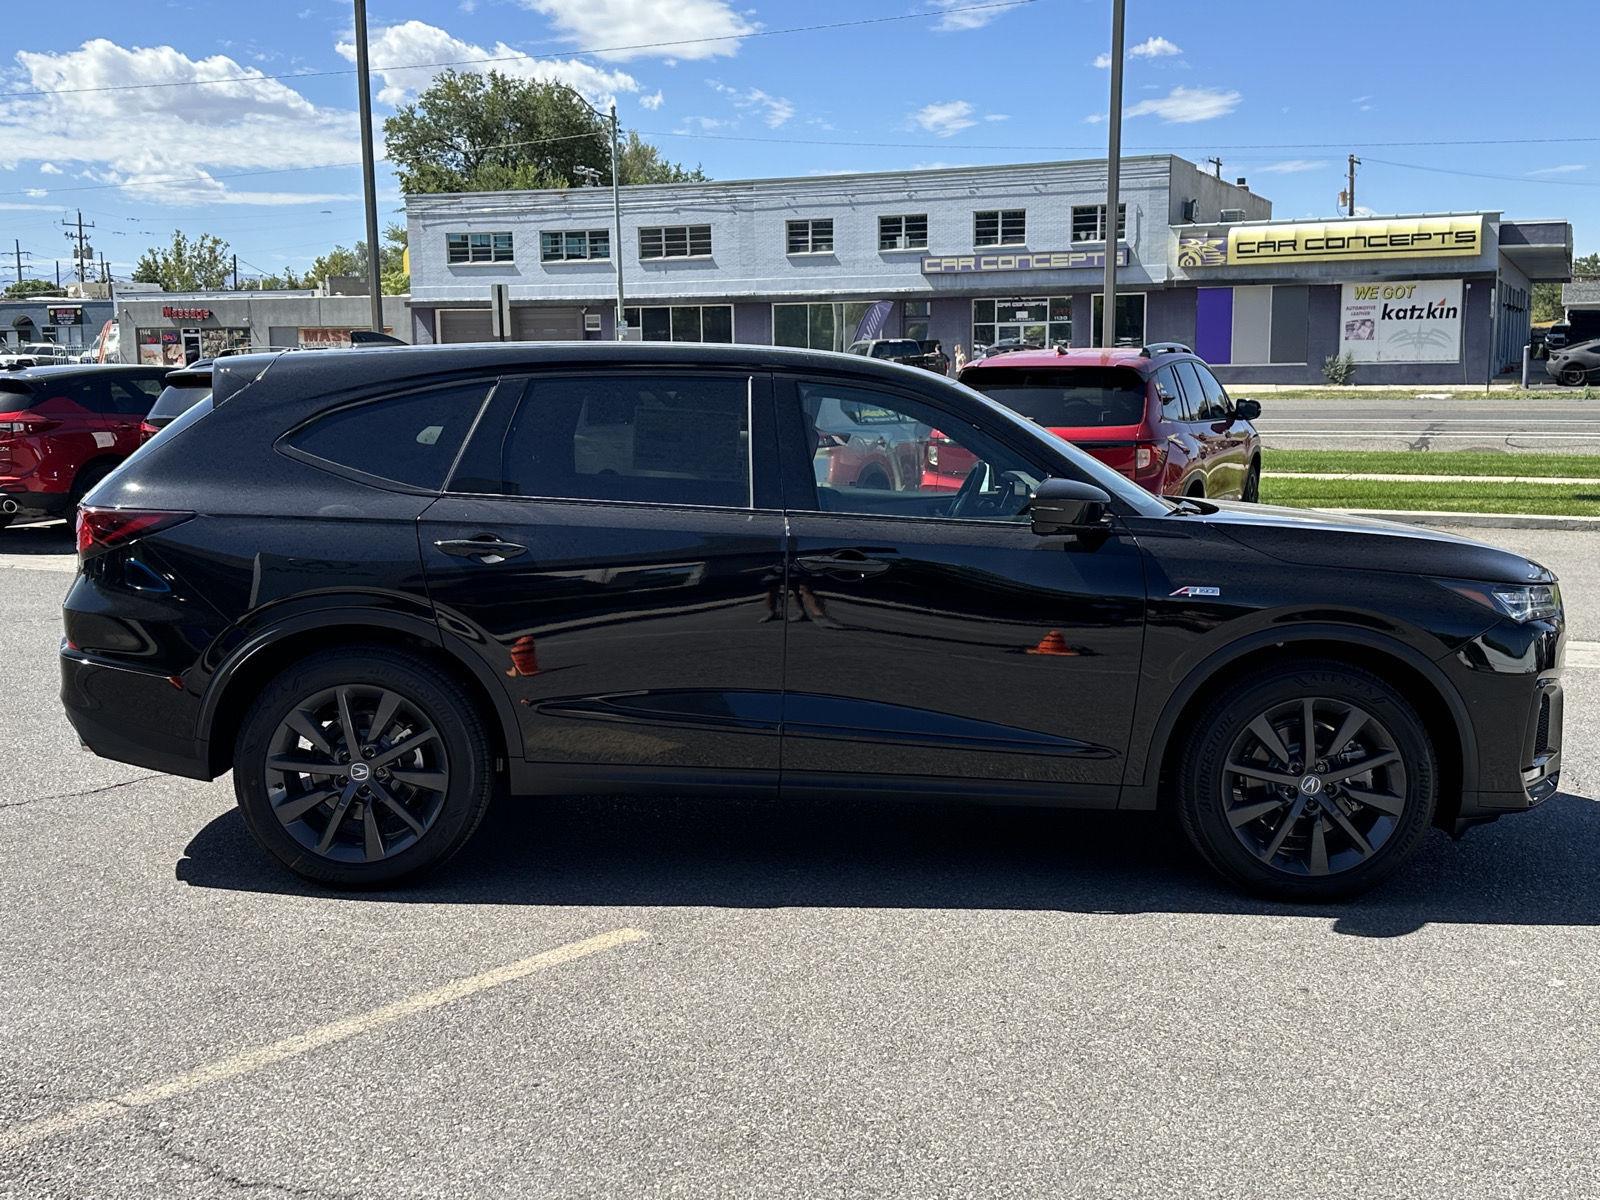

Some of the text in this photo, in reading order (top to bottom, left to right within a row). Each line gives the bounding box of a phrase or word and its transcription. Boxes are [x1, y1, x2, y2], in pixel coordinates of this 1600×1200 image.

[1236, 230, 1476, 254] CAR CONCEPTS
[924, 257, 976, 272] CAR
[1354, 284, 1416, 300] WE GOT
[162, 306, 210, 322] Massage
[1381, 298, 1458, 320] katzkin
